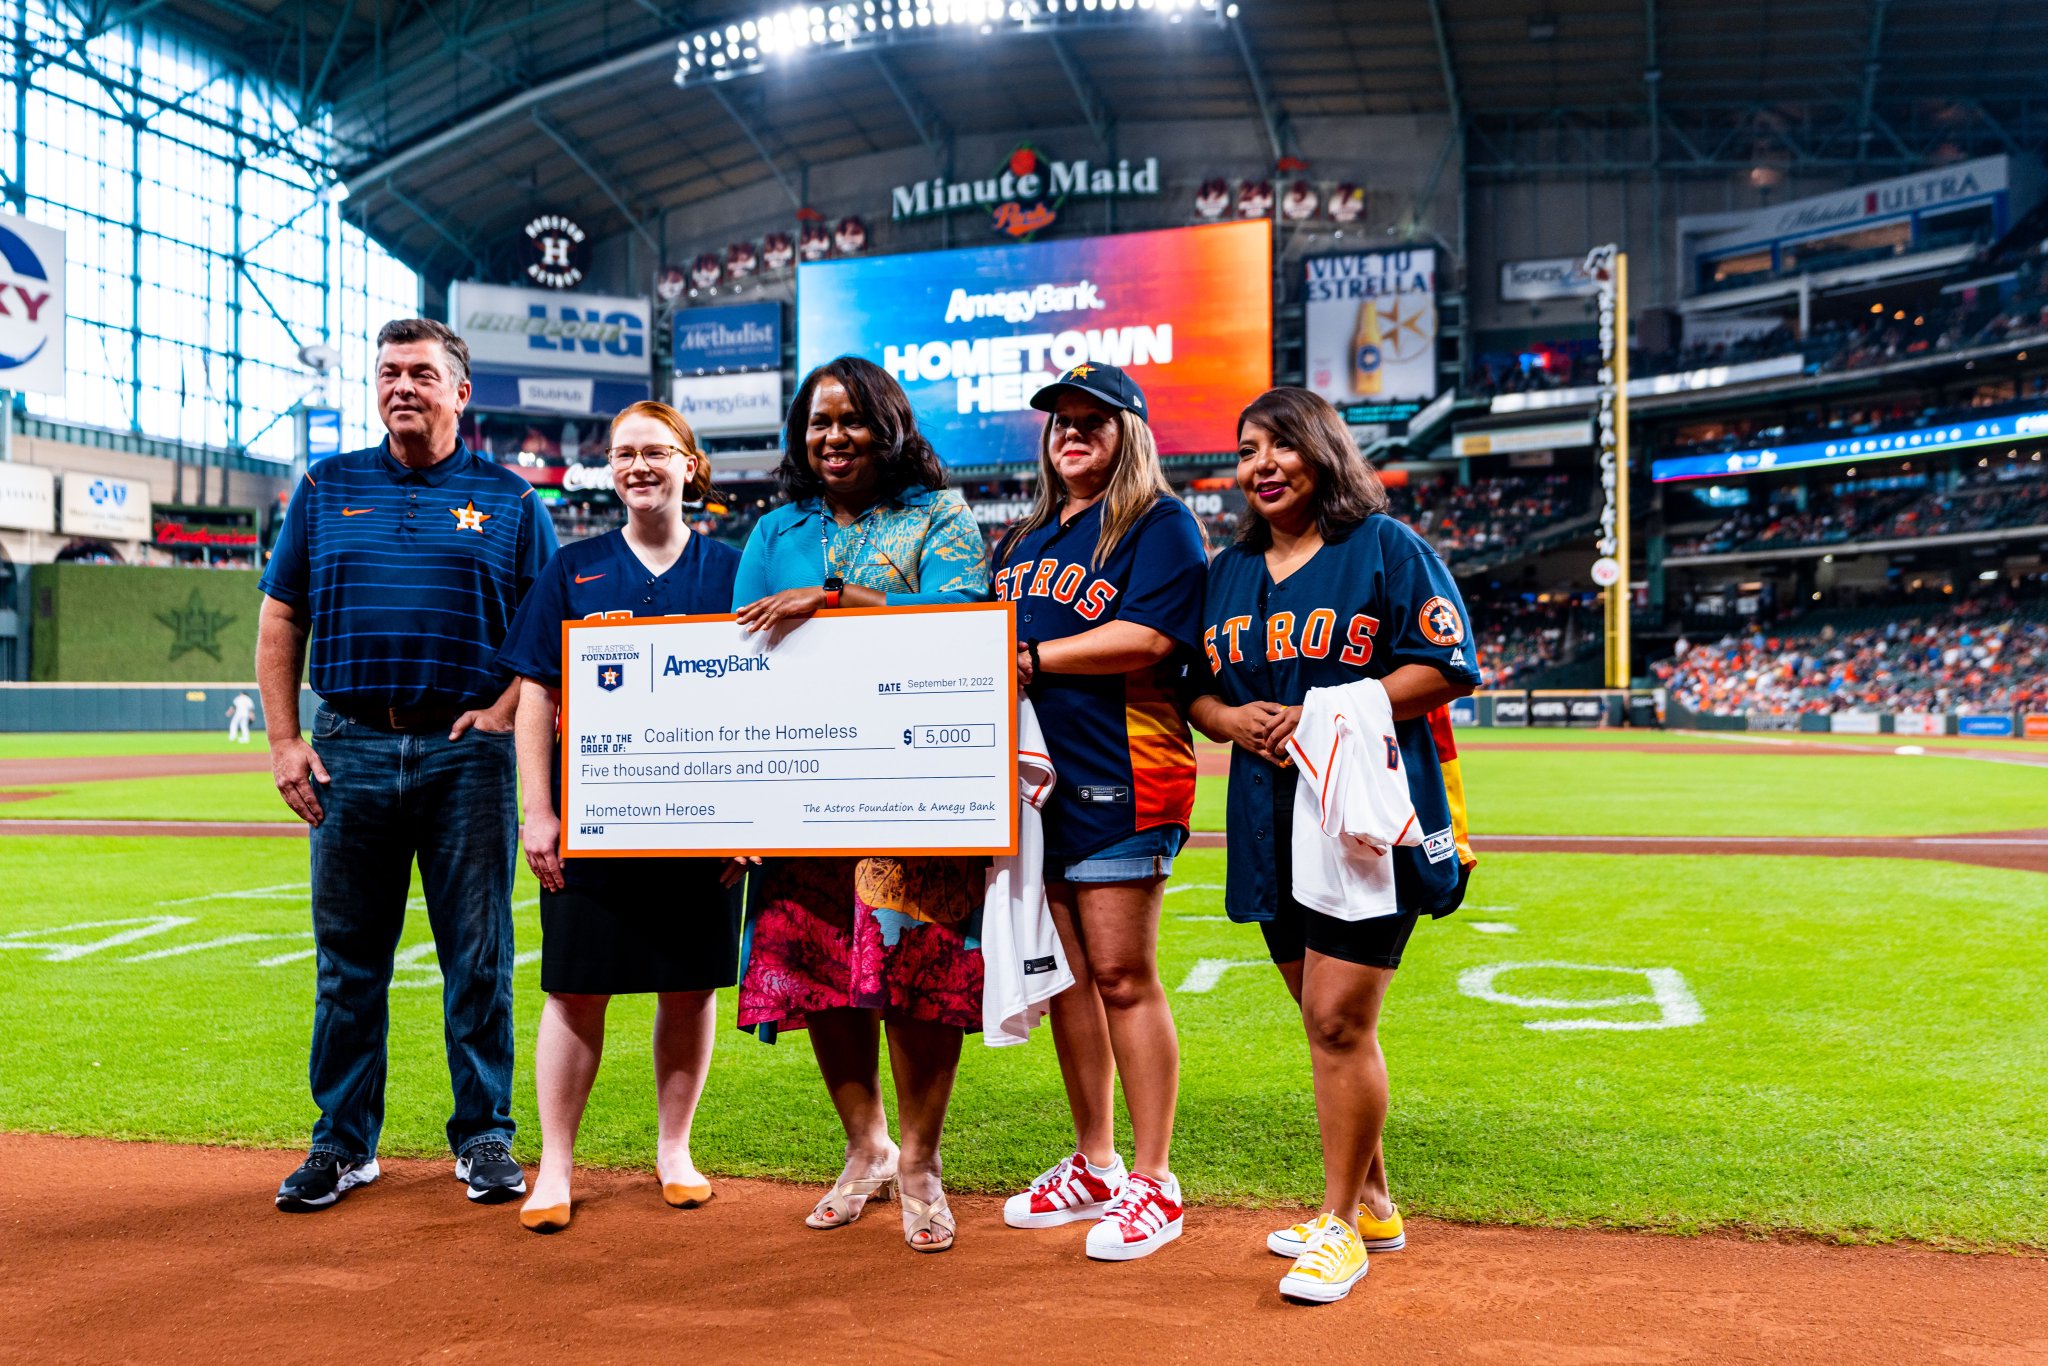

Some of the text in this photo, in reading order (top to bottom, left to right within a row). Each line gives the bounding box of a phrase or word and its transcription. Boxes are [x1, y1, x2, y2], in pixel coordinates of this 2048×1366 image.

[892, 170, 1040, 219] Minute
[1049, 158, 1158, 195] Maid
[1882, 173, 1981, 210] ULTRA
[541, 237, 569, 266] H
[1309, 251, 1411, 279] VIVE TU
[1307, 273, 1428, 300] ESTRELLA
[529, 305, 644, 358] LNG
[885, 323, 1173, 382] HOMETOWN
[528, 386, 583, 402] StubHub
[957, 372, 1066, 414] HER
[972, 502, 1034, 523] CHEVY
[995, 559, 1118, 620] STROS
[587, 644, 635, 653] THE ASTROS
[1203, 608, 1381, 677] STROS
[581, 652, 640, 661] FOUNDATION
[663, 653, 770, 678] AmegyBank
[879, 676, 994, 692] DATE September 17, 2022
[581, 734, 632, 744] PAY TO THE
[644, 724, 857, 743] Coalition for the Homeless
[903, 728, 971, 746] $ 5,000
[581, 744, 626, 753] ORDER OF:
[582, 759, 820, 777] Five thousand dollars and 00/100
[586, 803, 715, 817] Hometown Heroes
[803, 801, 996, 815] The Astros Foundation & Amegy Bank
[580, 826, 605, 834] MEMO
